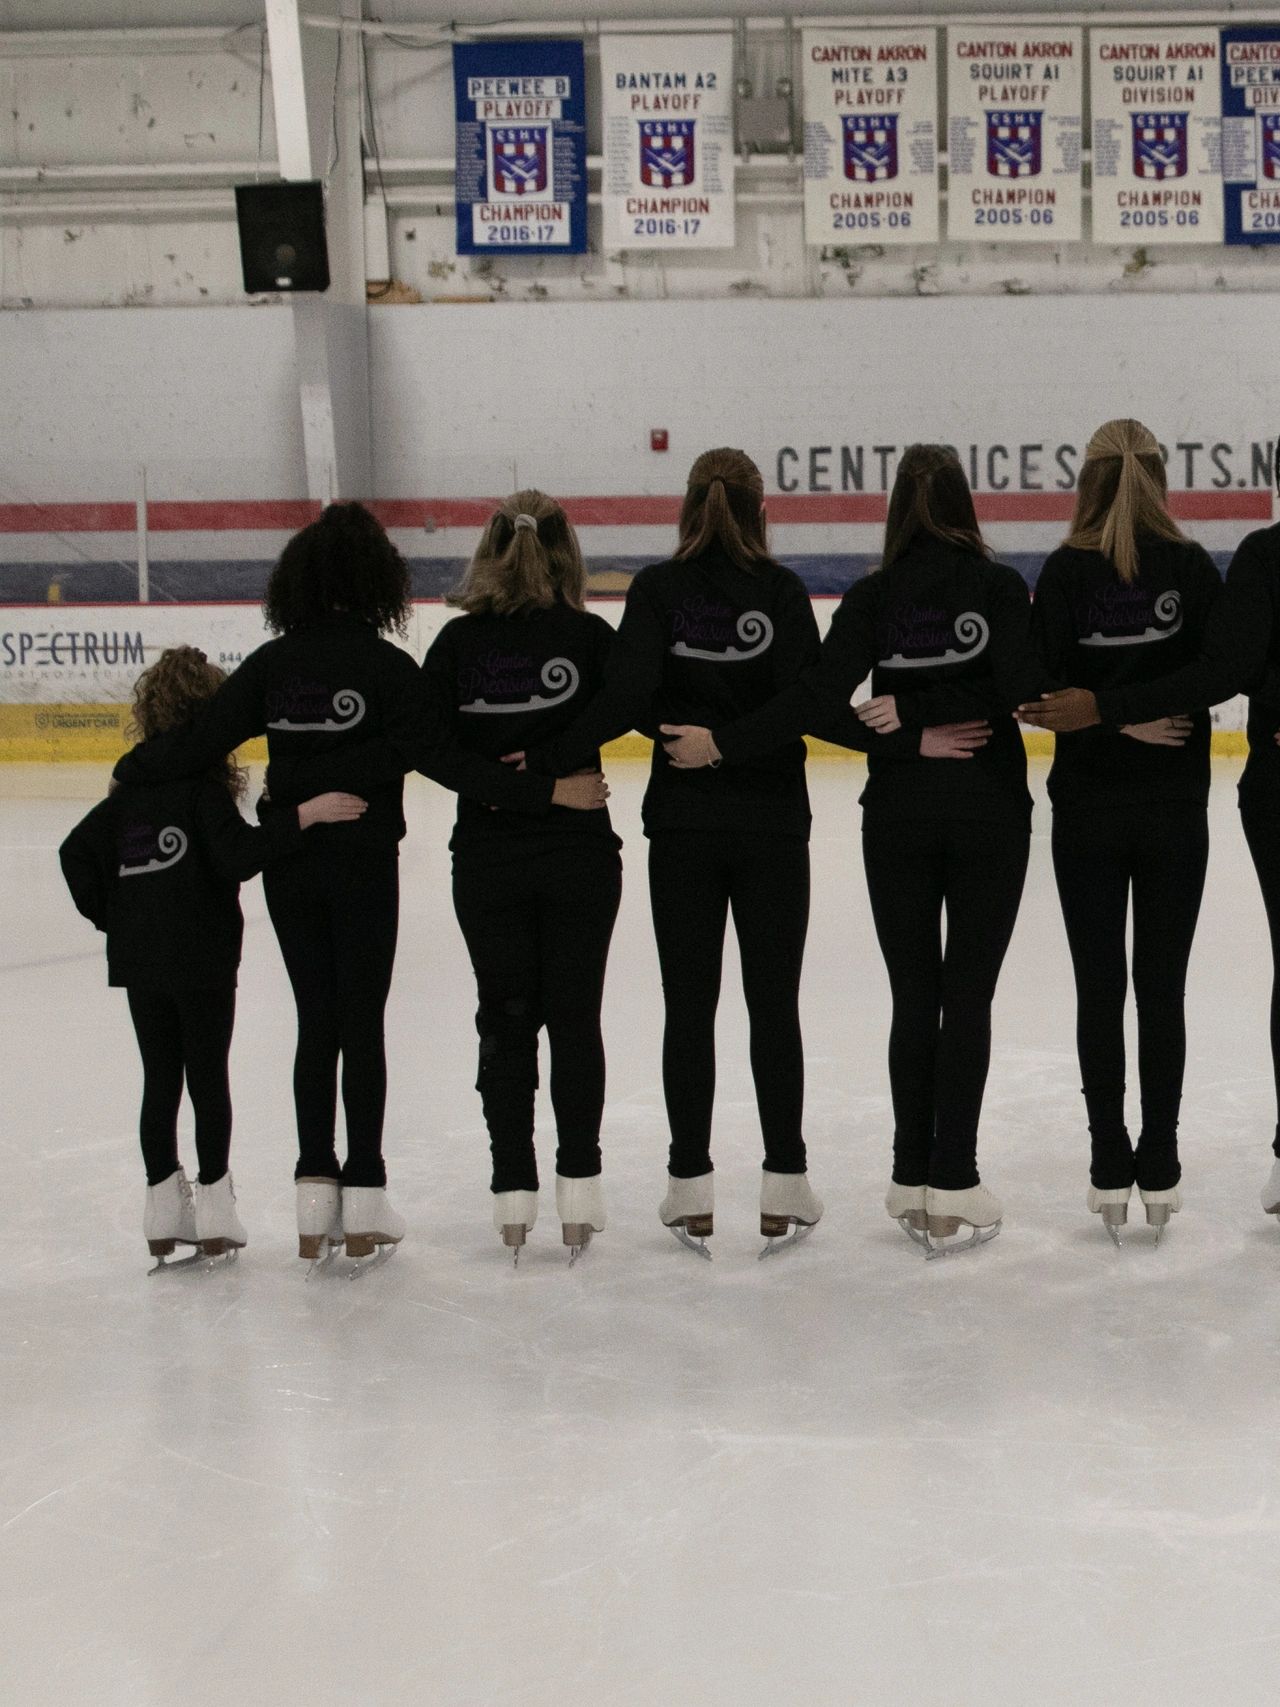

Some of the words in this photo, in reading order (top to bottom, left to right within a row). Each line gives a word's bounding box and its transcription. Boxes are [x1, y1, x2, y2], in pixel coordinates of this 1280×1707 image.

[811, 46, 871, 63] CANTON
[877, 45, 927, 61] AKRON
[957, 42, 1017, 58] CANTON
[1022, 41, 1073, 57] AKRON
[1100, 44, 1160, 60] CANTON
[1165, 43, 1216, 59] AKRON
[616, 72, 687, 89] BANTAM
[695, 72, 717, 89] A2
[832, 67, 873, 84] MITE
[886, 67, 908, 83] A3
[970, 64, 1034, 81] SQUIRT
[1043, 64, 1060, 80] A1
[1113, 65, 1177, 82] SQUIRT
[1187, 65, 1203, 81] A1
[471, 79, 544, 96] PEEWEE
[556, 78, 567, 95] B
[979, 85, 1050, 101] PLAYOFF
[1122, 86, 1195, 102] DIVISION
[631, 94, 702, 110] PLAYOFF
[835, 89, 905, 105] PLAYOFF
[483, 101, 554, 117] PLAYOFF
[830, 192, 913, 209] CHAMPION
[972, 188, 1056, 205] CHAMPION
[1117, 190, 1202, 206] CHAMPION
[480, 204, 562, 221] CHAMPION
[626, 198, 710, 214] CHAMPION
[2, 631, 145, 666] SPECTRUM
